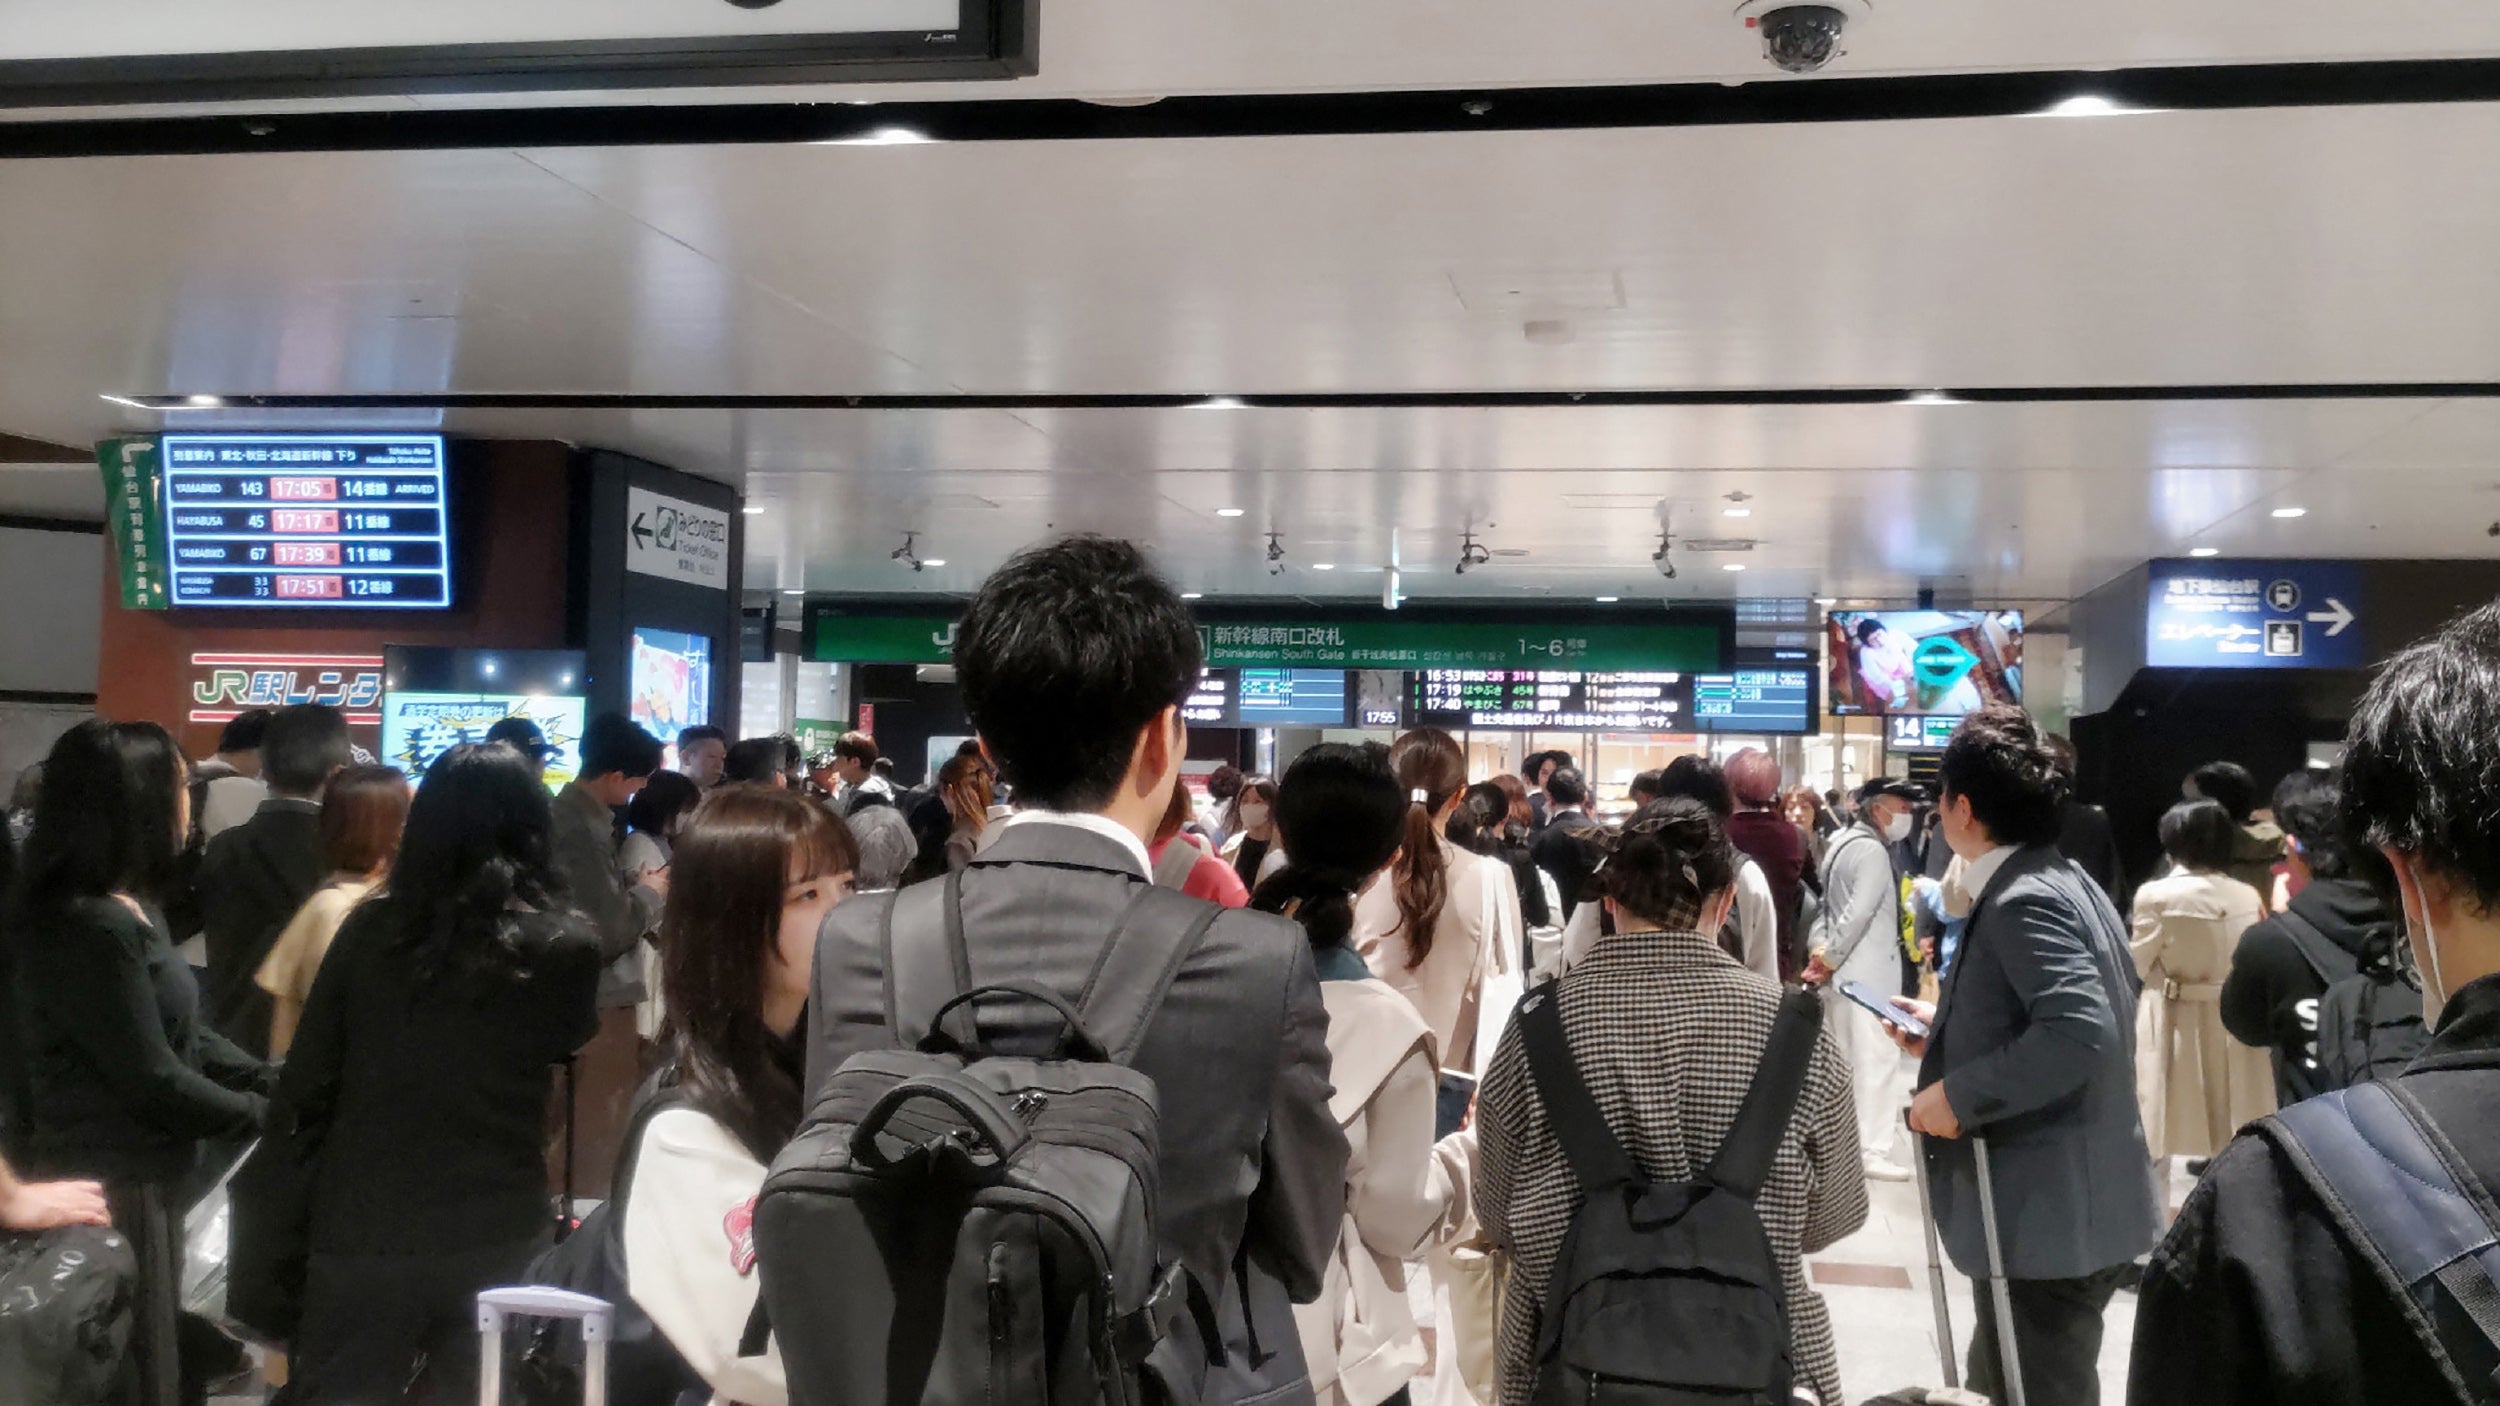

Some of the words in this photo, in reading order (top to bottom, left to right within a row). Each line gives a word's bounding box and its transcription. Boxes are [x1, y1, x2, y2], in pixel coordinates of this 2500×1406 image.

[241, 482, 263, 495] 143
[276, 481, 321, 496] 17:05
[249, 515, 265, 528] 45
[278, 514, 322, 529] 17:17
[250, 547, 267, 560] 67
[279, 547, 324, 562] 17:39
[254, 577, 268, 585] 33
[281, 579, 325, 595] 17:51
[254, 587, 269, 596] 33
[932, 623, 960, 645] J
[1214, 626, 1345, 646] 新幹線南口改札
[1214, 649, 1278, 658] Shinkansen
[1281, 649, 1314, 659] South
[1317, 649, 1345, 659] Gate
[194, 670, 383, 707] JR駅レンタ
[1426, 684, 1461, 696] 17:19
[1463, 685, 1502, 696] はやぶさ
[1426, 698, 1461, 710] 17:40
[1463, 700, 1502, 710] やまびこ
[1894, 717, 1920, 737] 14
